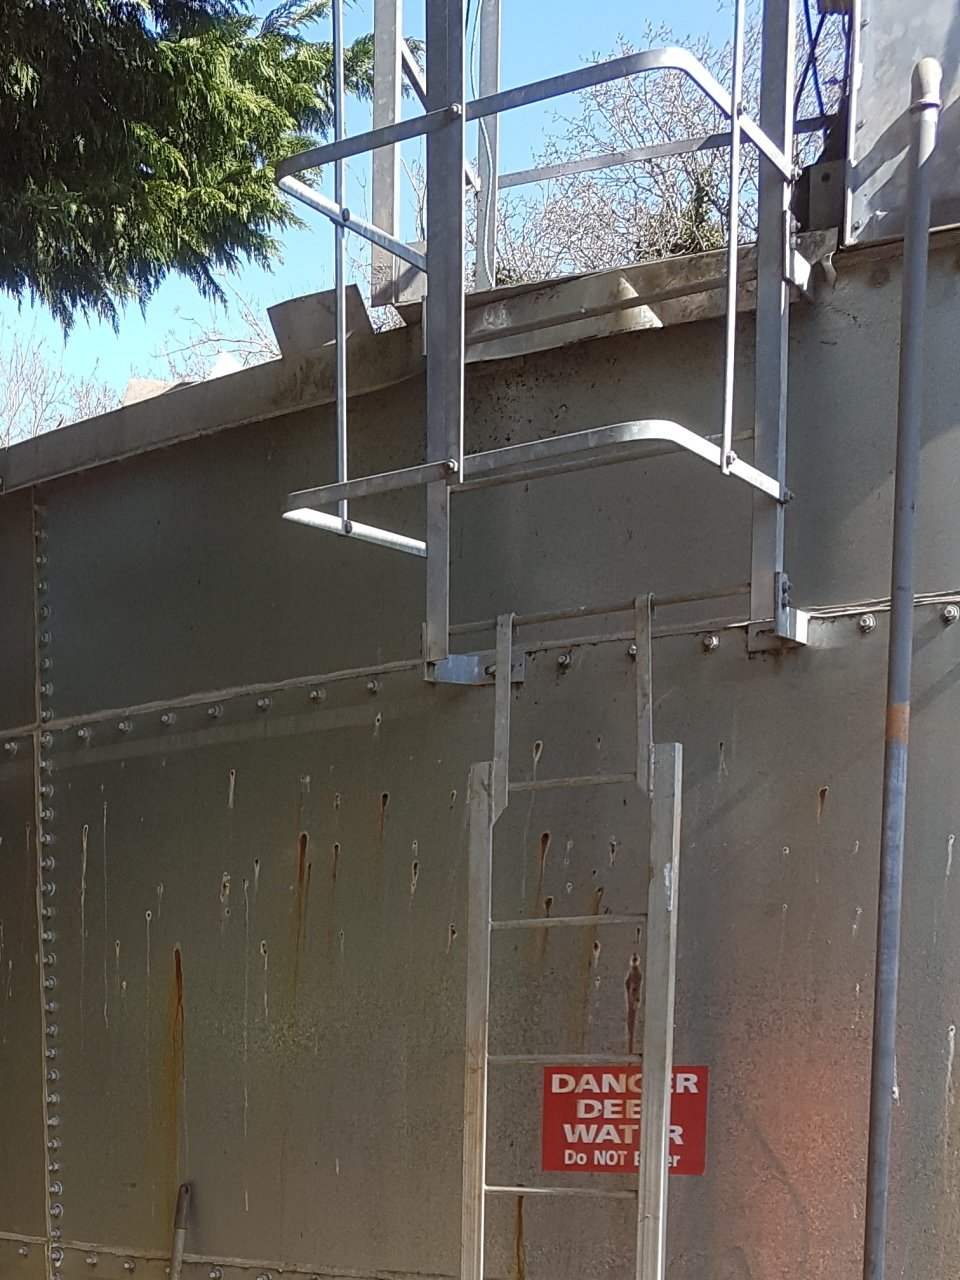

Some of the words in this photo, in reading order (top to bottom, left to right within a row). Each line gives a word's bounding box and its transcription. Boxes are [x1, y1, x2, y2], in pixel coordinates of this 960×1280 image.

[576, 1099, 642, 1119] DEE
[563, 1124, 684, 1145] WATR
[564, 1149, 587, 1165] Do
[593, 1150, 628, 1166] NOT
[633, 1151, 681, 1168] Eer
